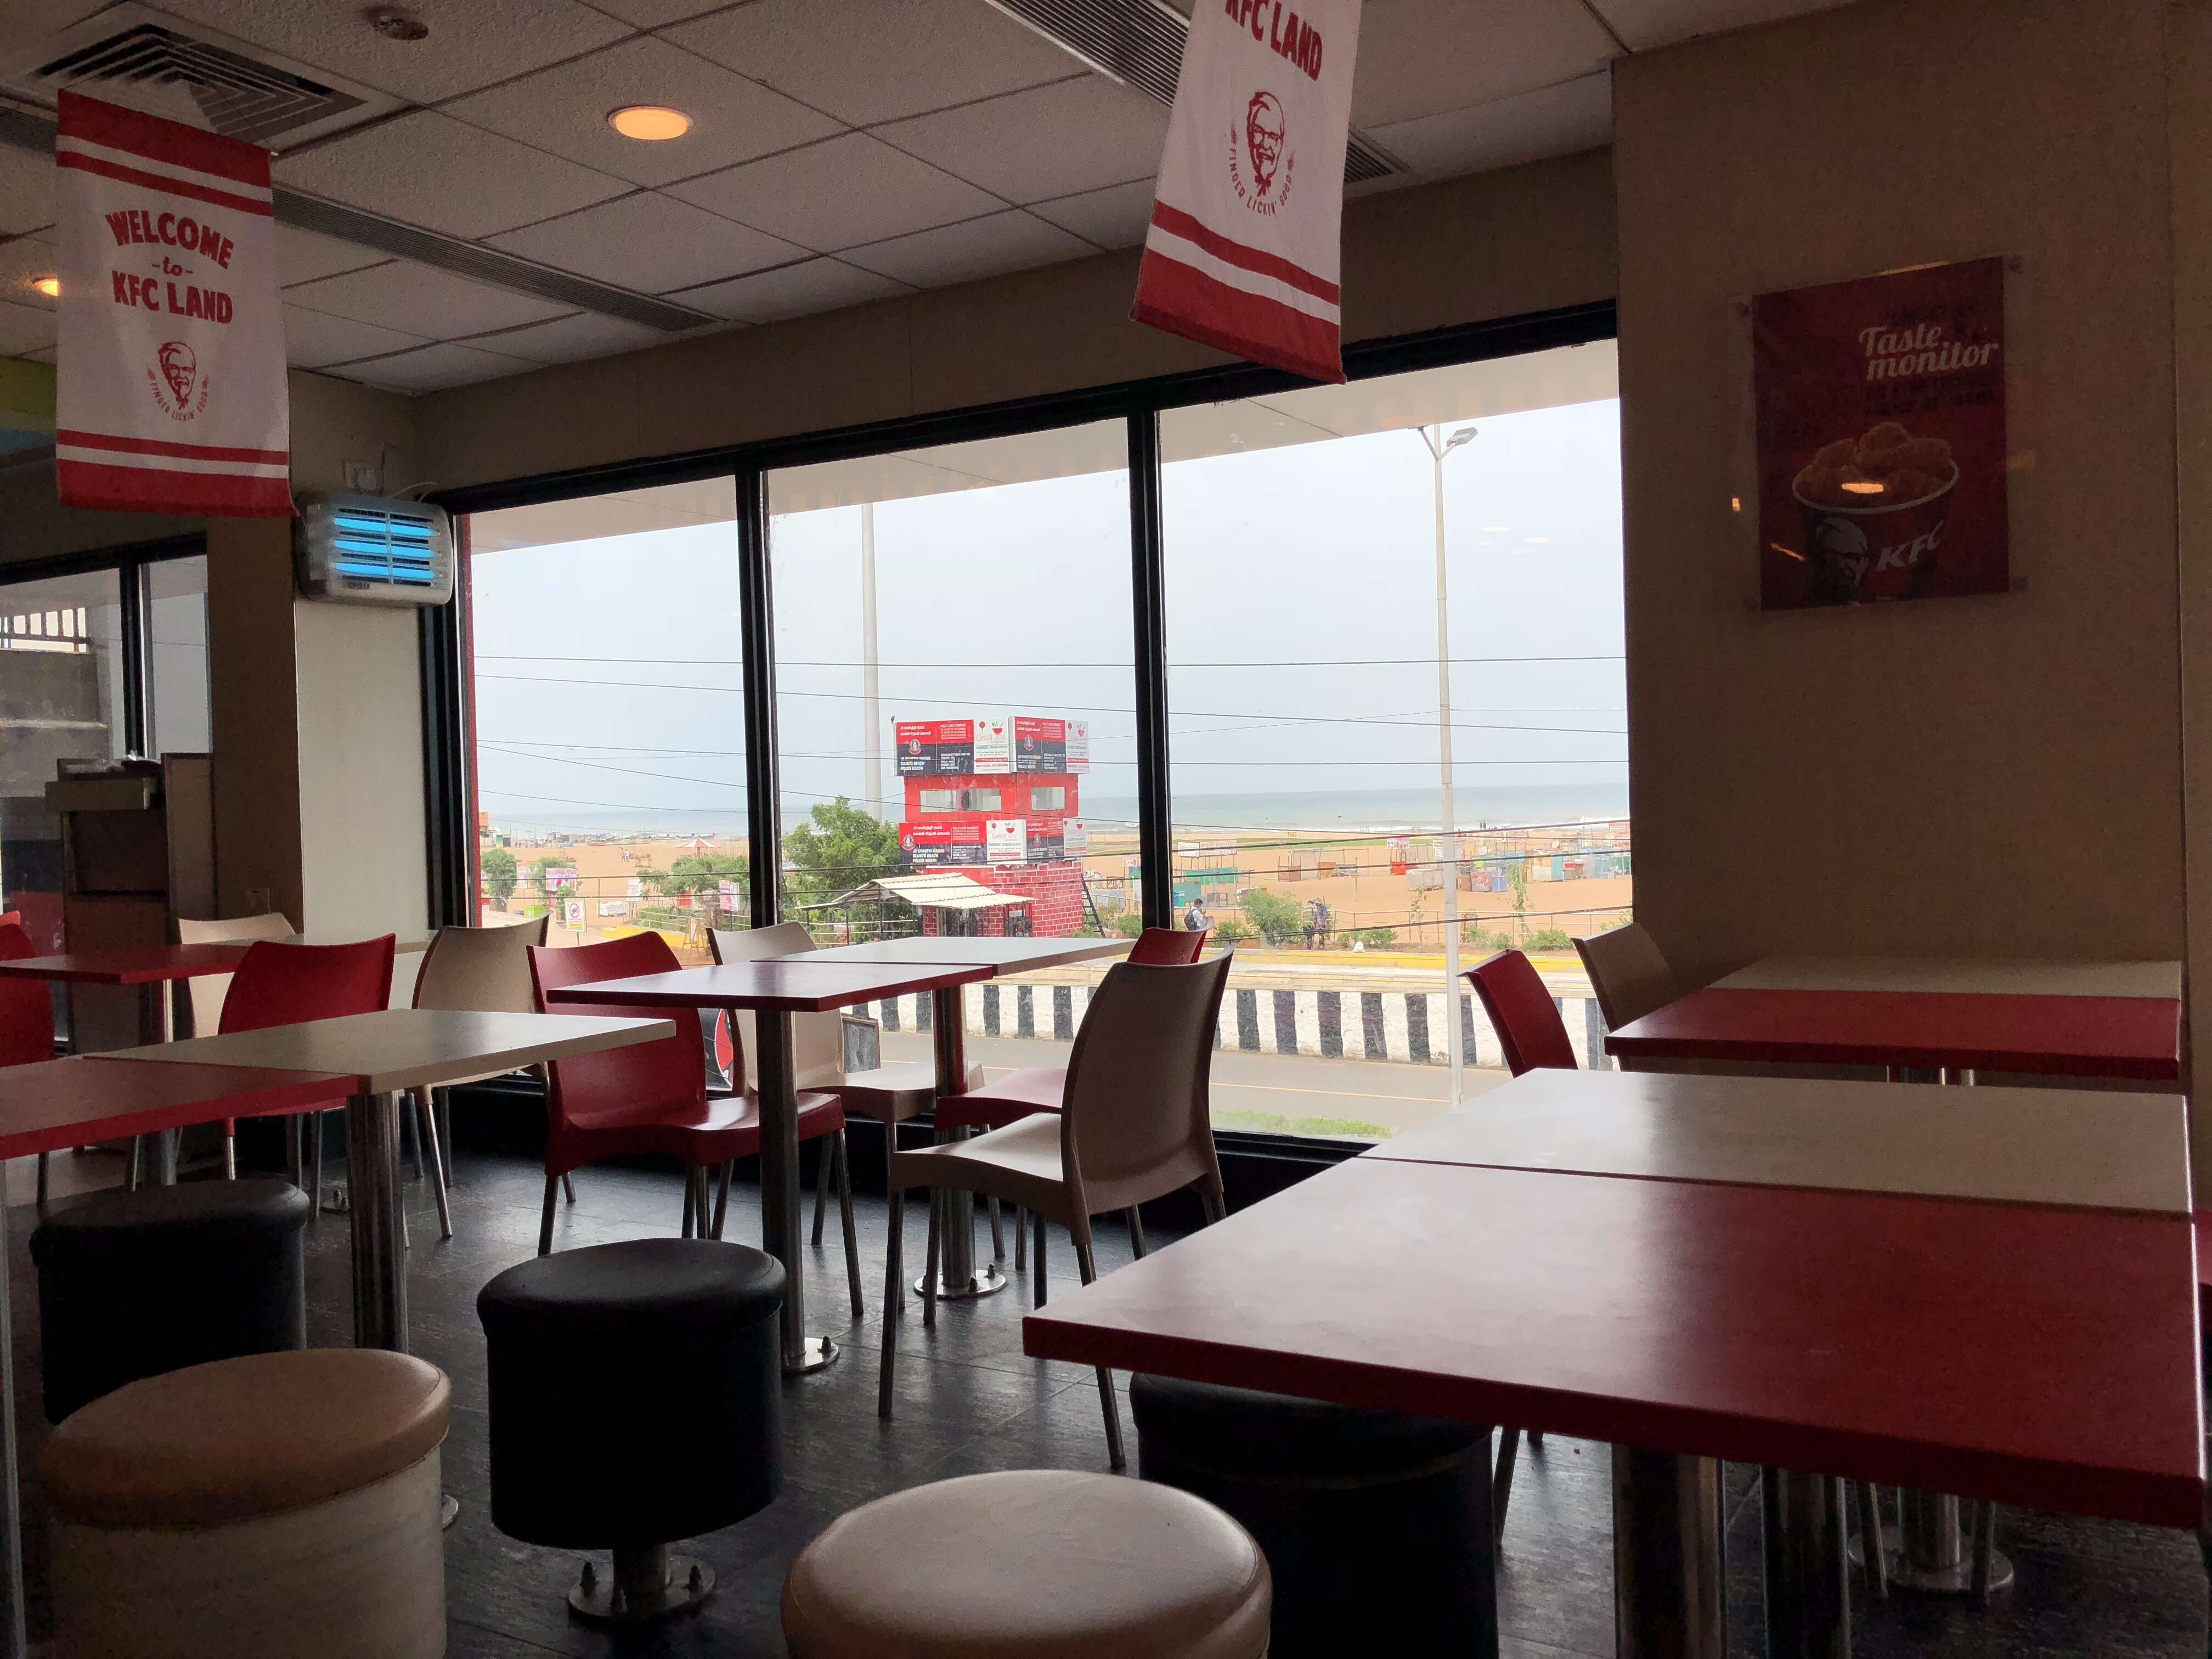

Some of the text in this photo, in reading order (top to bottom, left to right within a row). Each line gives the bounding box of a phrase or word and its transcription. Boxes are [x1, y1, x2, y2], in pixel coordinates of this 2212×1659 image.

[1271, 1, 1323, 81] LAND
[1229, 148, 1245, 199] FINGER
[104, 210, 236, 270] WELCOME
[111, 270, 233, 324] KFC LAND
[1859, 323, 1942, 357] Taste
[1866, 342, 1999, 381] monitor
[1875, 520, 1944, 571] KFC
